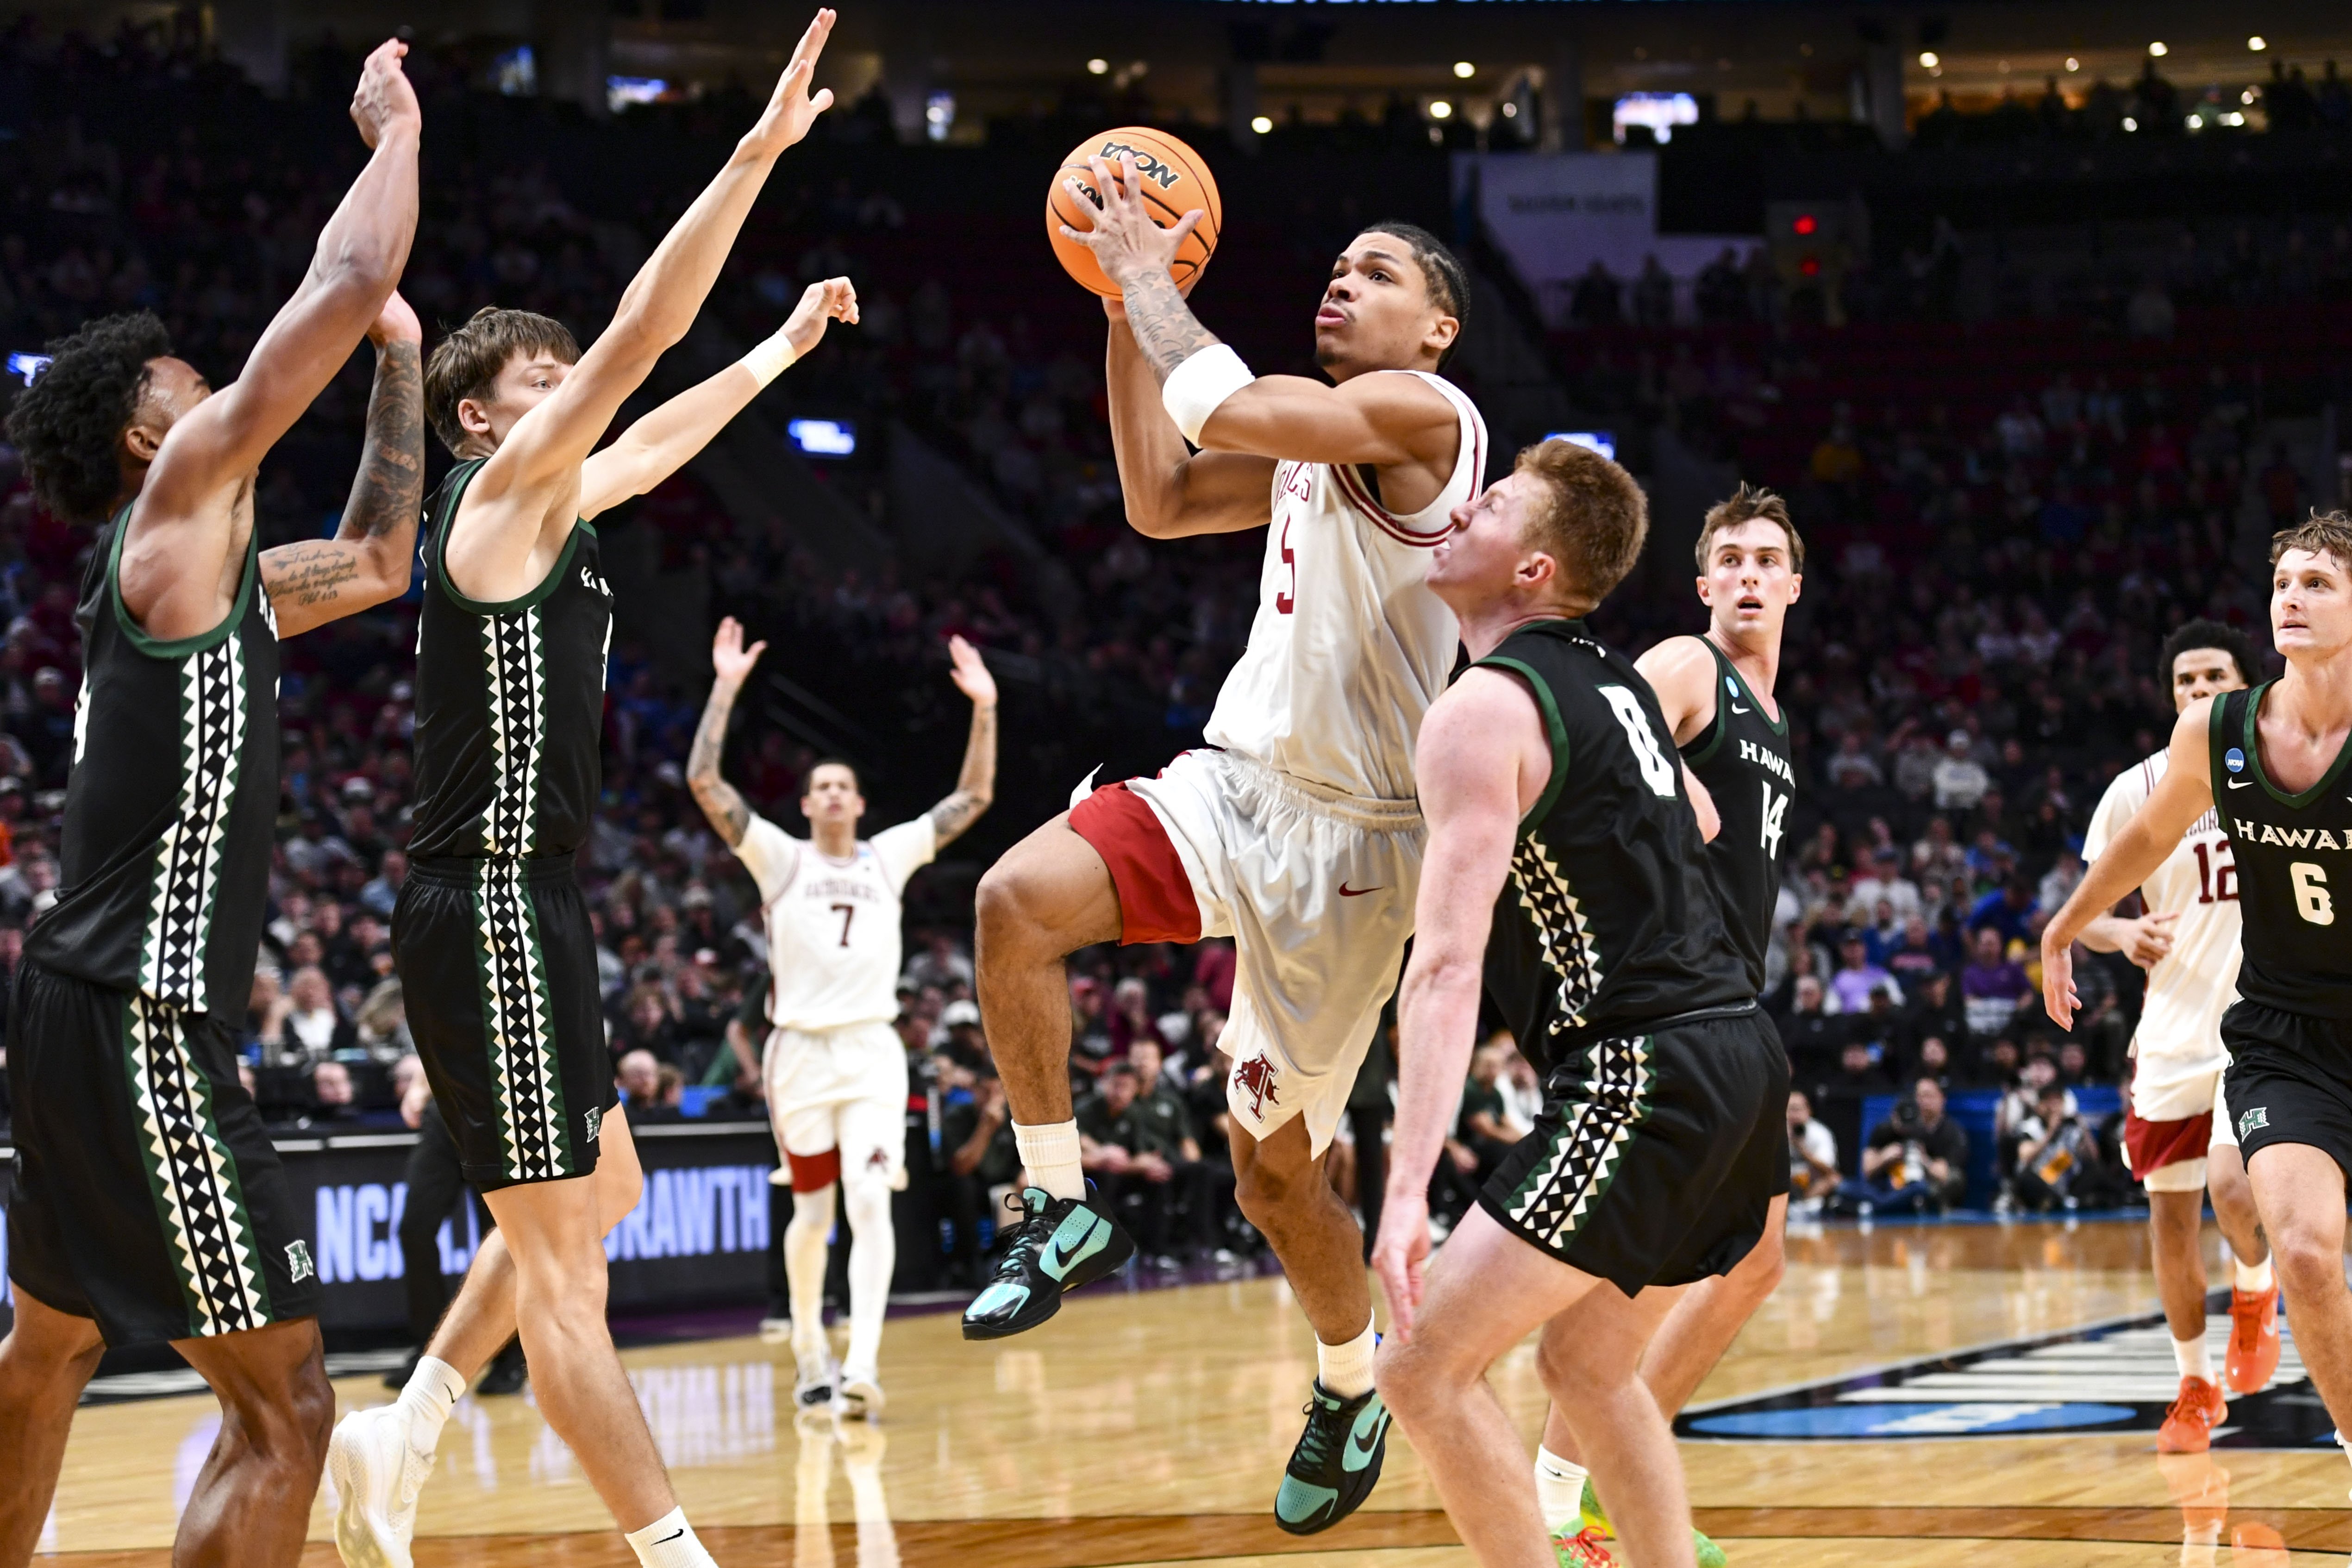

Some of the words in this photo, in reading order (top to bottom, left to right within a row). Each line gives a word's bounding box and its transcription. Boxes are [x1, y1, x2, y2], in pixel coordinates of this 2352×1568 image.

[1597, 685, 1676, 798] 0
[1739, 739, 1795, 788] HAWA
[1760, 780, 1789, 861] 14
[2193, 840, 2239, 904] 12
[2289, 862, 2335, 926] 6
[830, 904, 854, 948] 7
[604, 1166, 770, 1262] RAWTH
